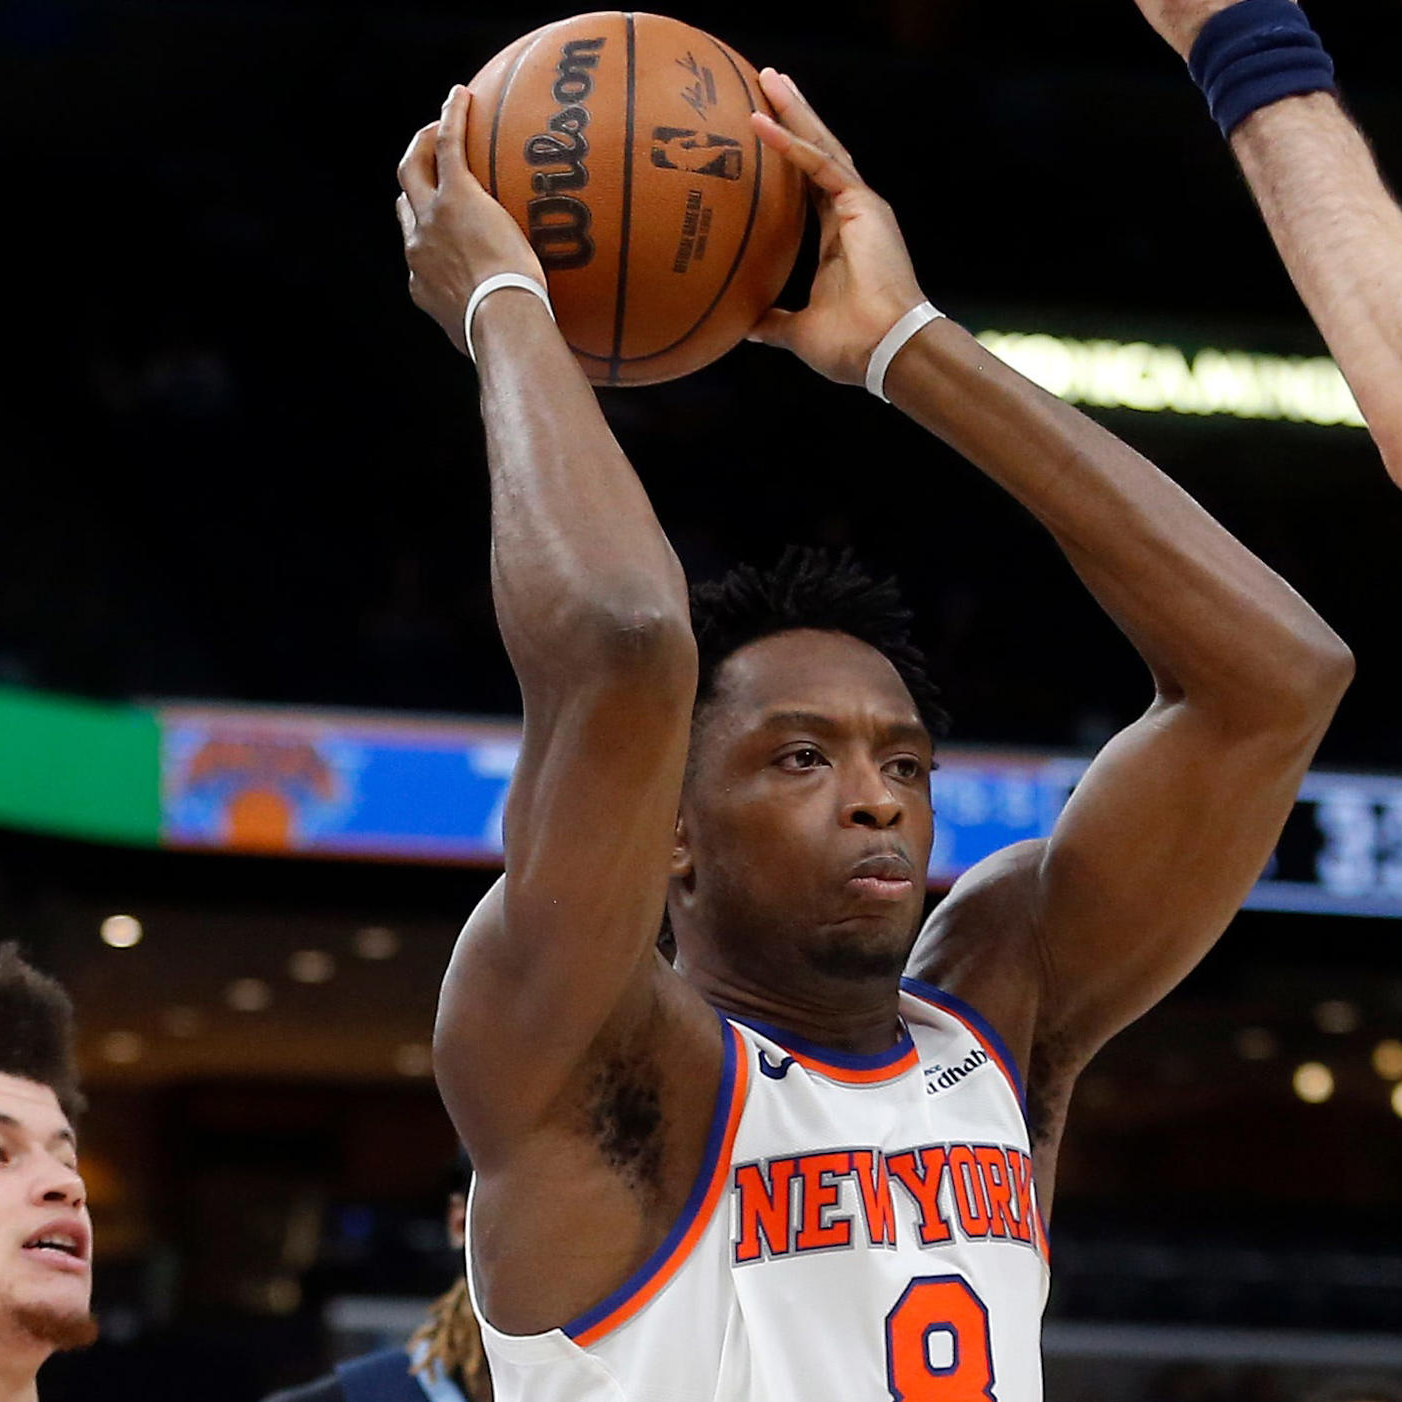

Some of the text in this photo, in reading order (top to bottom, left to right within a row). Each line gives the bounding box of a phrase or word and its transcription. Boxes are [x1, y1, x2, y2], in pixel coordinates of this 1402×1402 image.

[524, 37, 606, 271] Wilson
[937, 1049, 989, 1089] dhab
[731, 1145, 897, 1268] NEW
